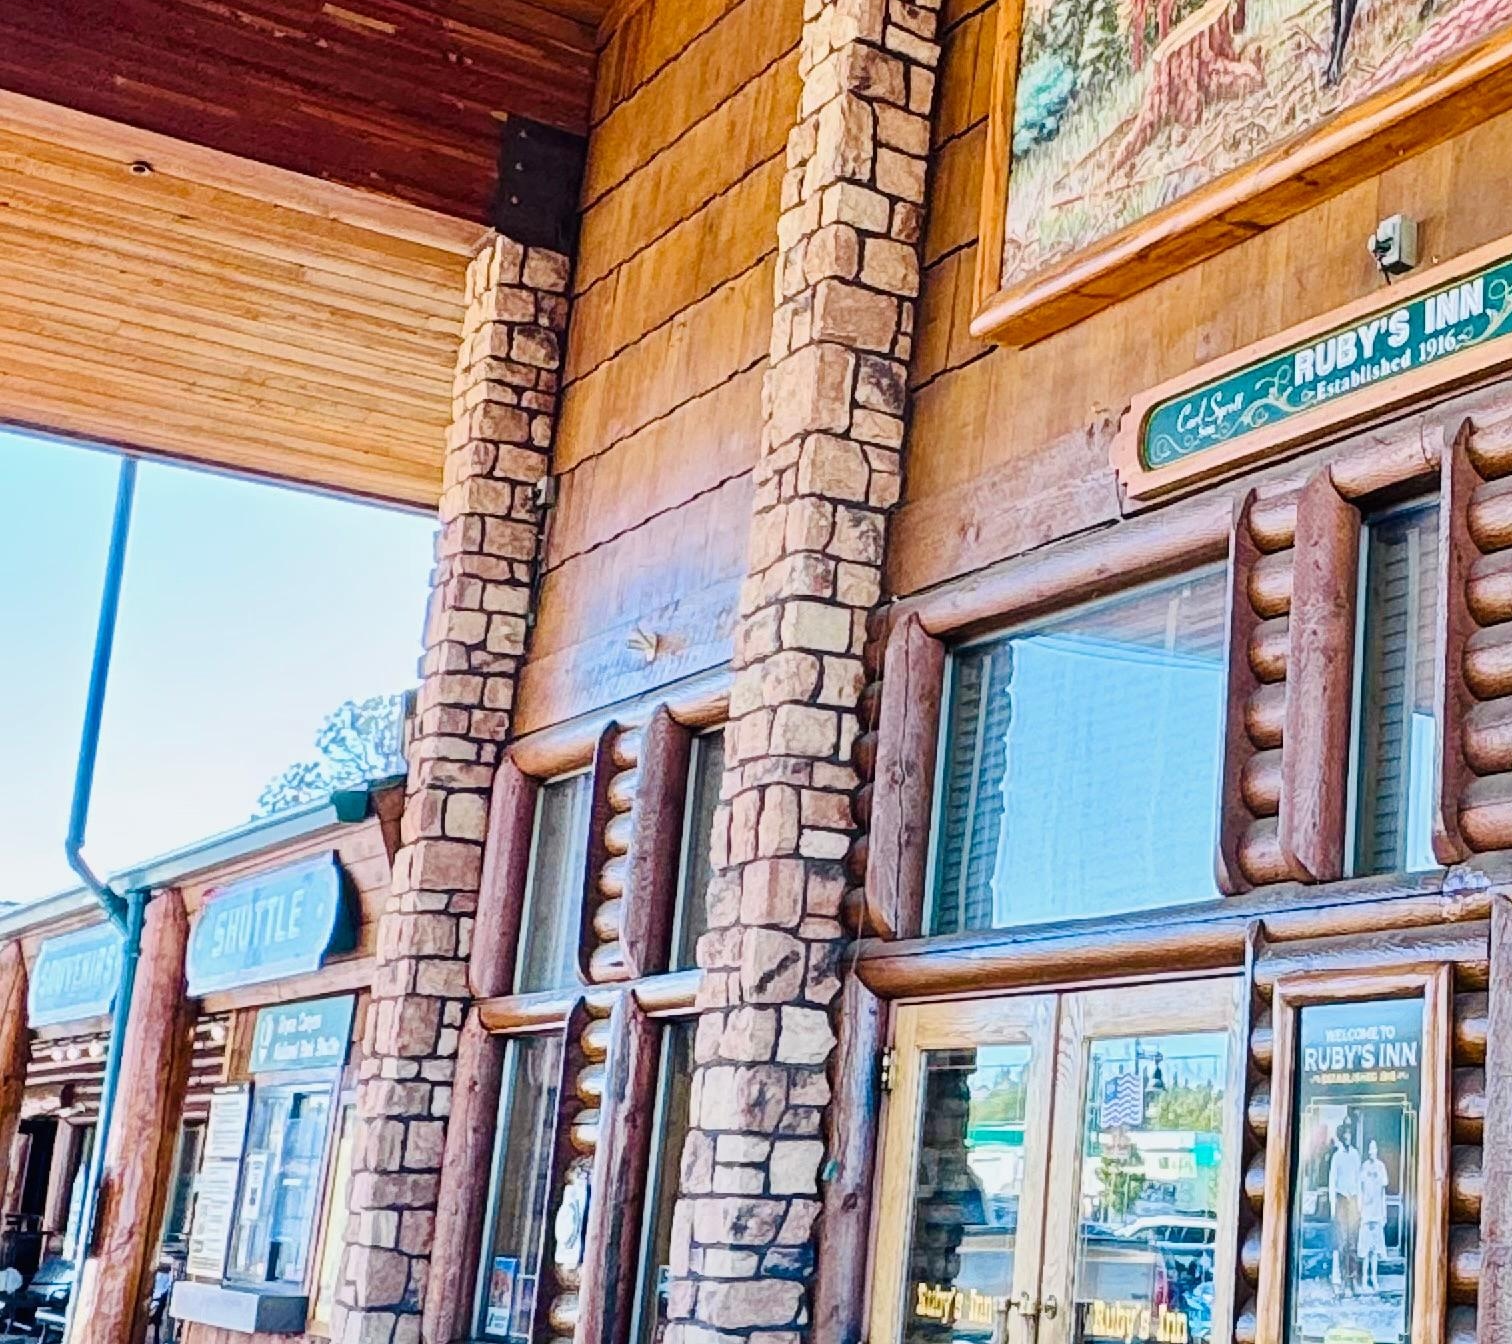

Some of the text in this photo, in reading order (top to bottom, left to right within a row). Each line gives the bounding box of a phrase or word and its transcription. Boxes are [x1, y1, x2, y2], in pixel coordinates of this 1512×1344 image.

[1294, 278, 1485, 388] RUBY'S INN
[1315, 330, 1456, 400] Established 1916
[212, 888, 306, 957] SHUTTLE
[1303, 1040, 1418, 1072] RUBY'S INN
[1379, 1024, 1396, 1040] TO
